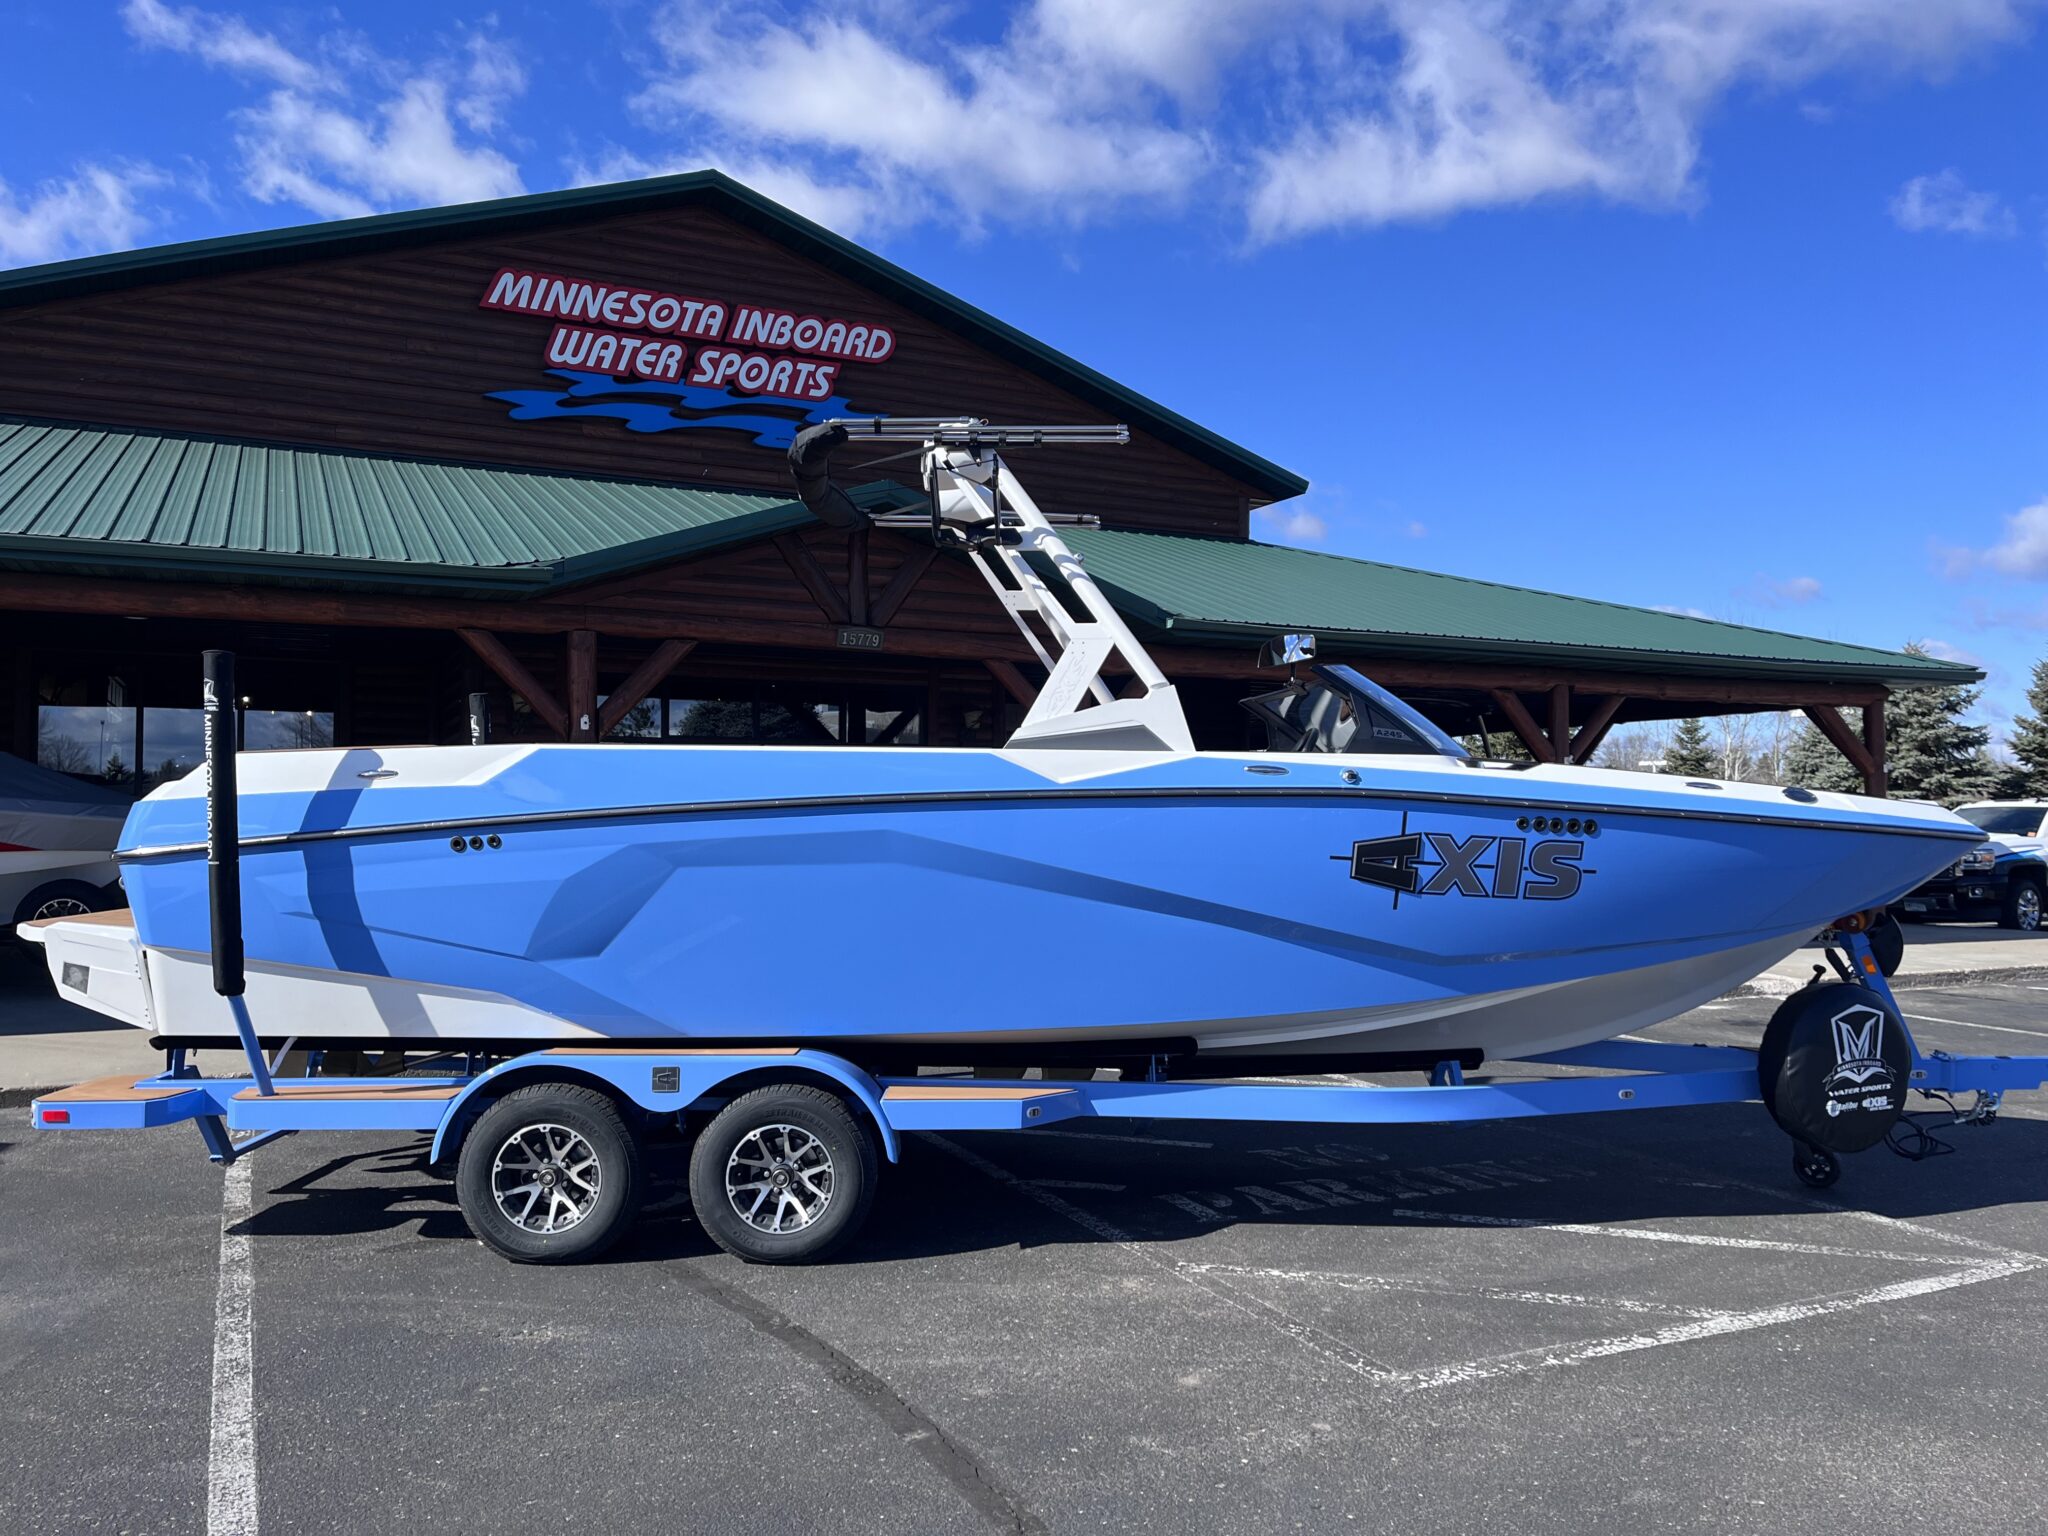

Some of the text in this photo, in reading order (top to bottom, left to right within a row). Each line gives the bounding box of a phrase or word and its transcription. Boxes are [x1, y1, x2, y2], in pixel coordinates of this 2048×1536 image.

[488, 272, 892, 359] MINNESOTA INBOARD
[549, 328, 835, 398] WATER SPORTS
[840, 632, 880, 647] 15779
[1351, 832, 1585, 901] AXIS
[1828, 1083, 1892, 1098] WATER SPORTS
